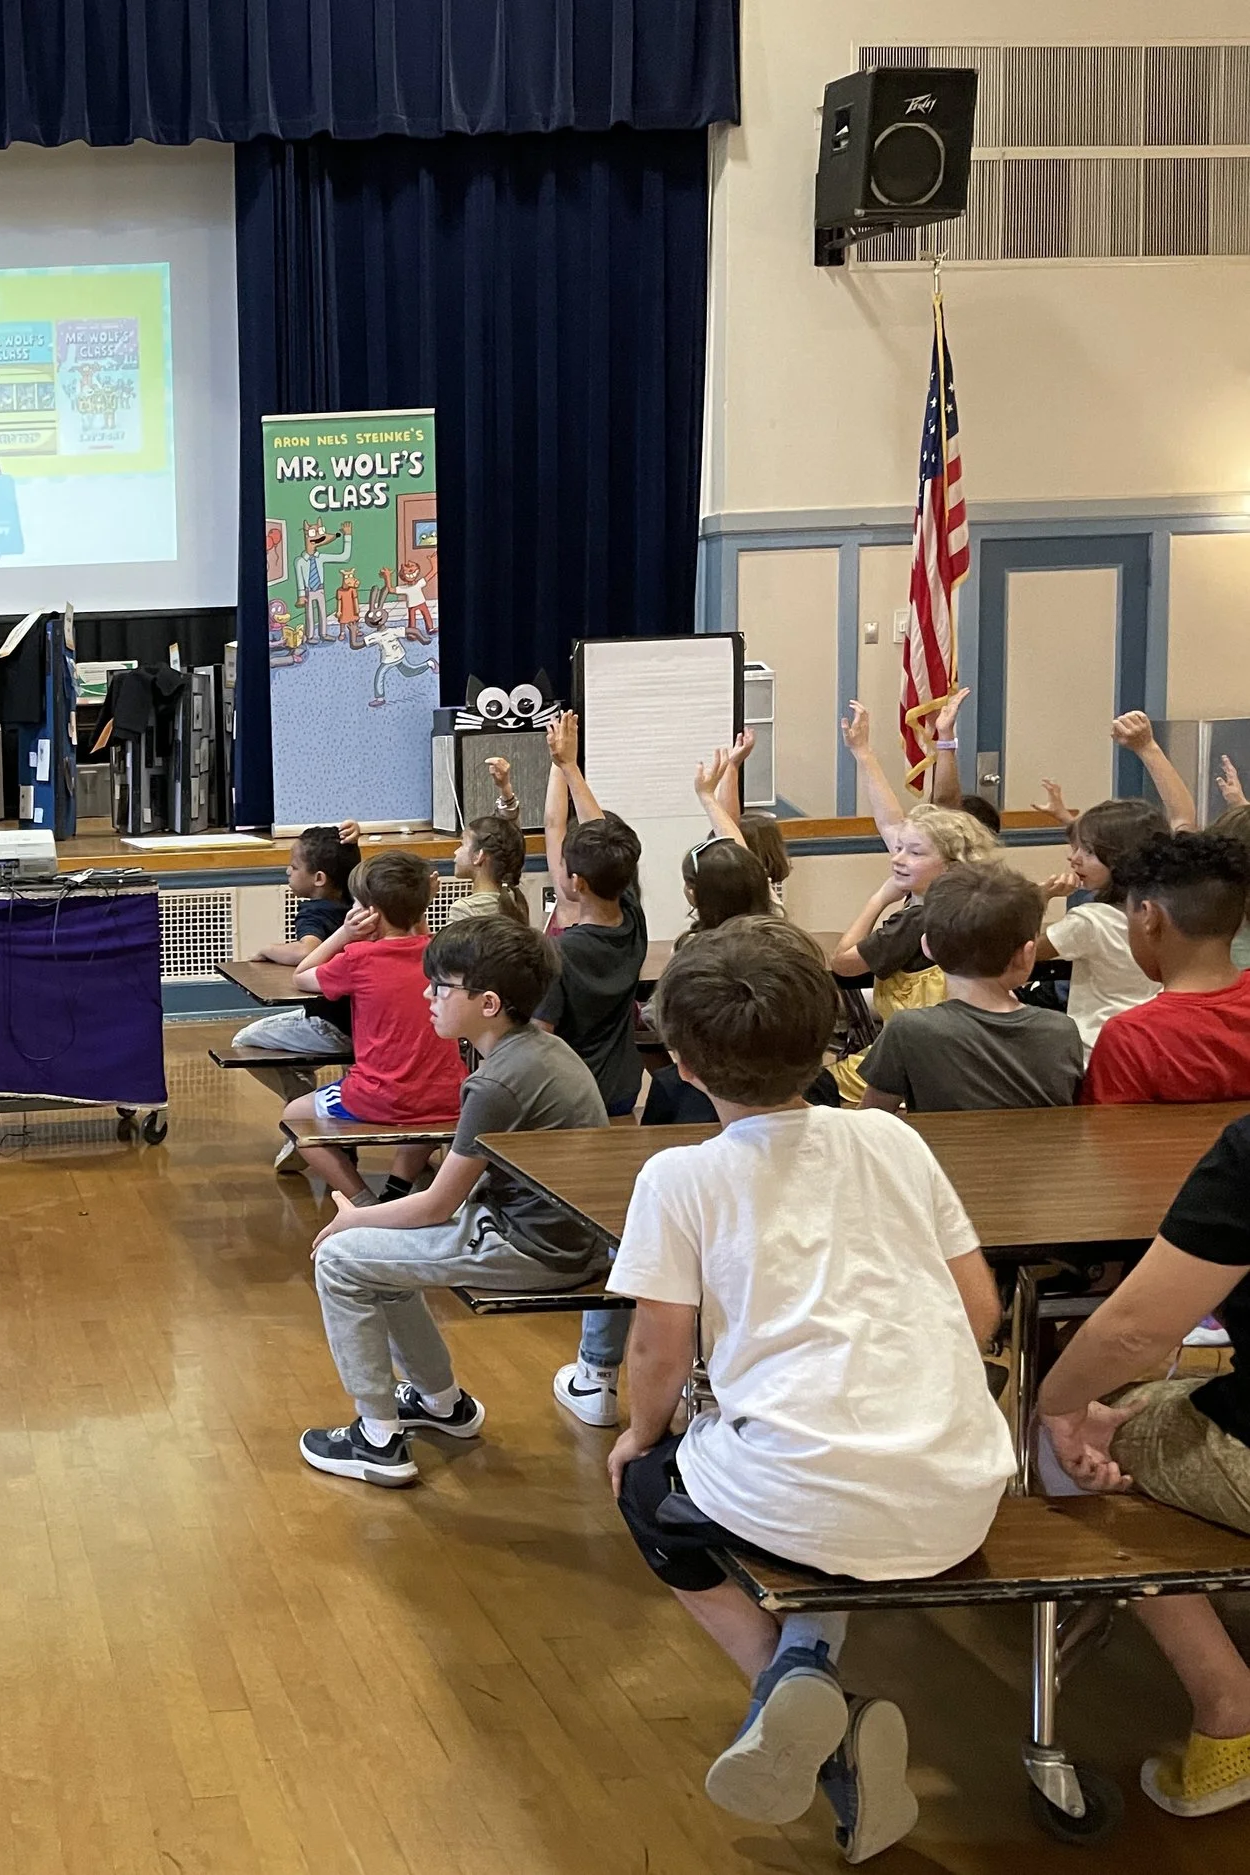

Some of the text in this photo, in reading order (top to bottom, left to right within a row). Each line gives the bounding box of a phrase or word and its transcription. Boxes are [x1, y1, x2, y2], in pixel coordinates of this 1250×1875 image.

[5, 334, 45, 346] WOLF'S
[66, 331, 130, 345] MR. WOLF'S
[80, 345, 114, 358] CLASS
[274, 428, 424, 448] ARON NELS STEINKE'S
[276, 450, 424, 481] MR. WOLF'S
[309, 482, 388, 510] CLASS
